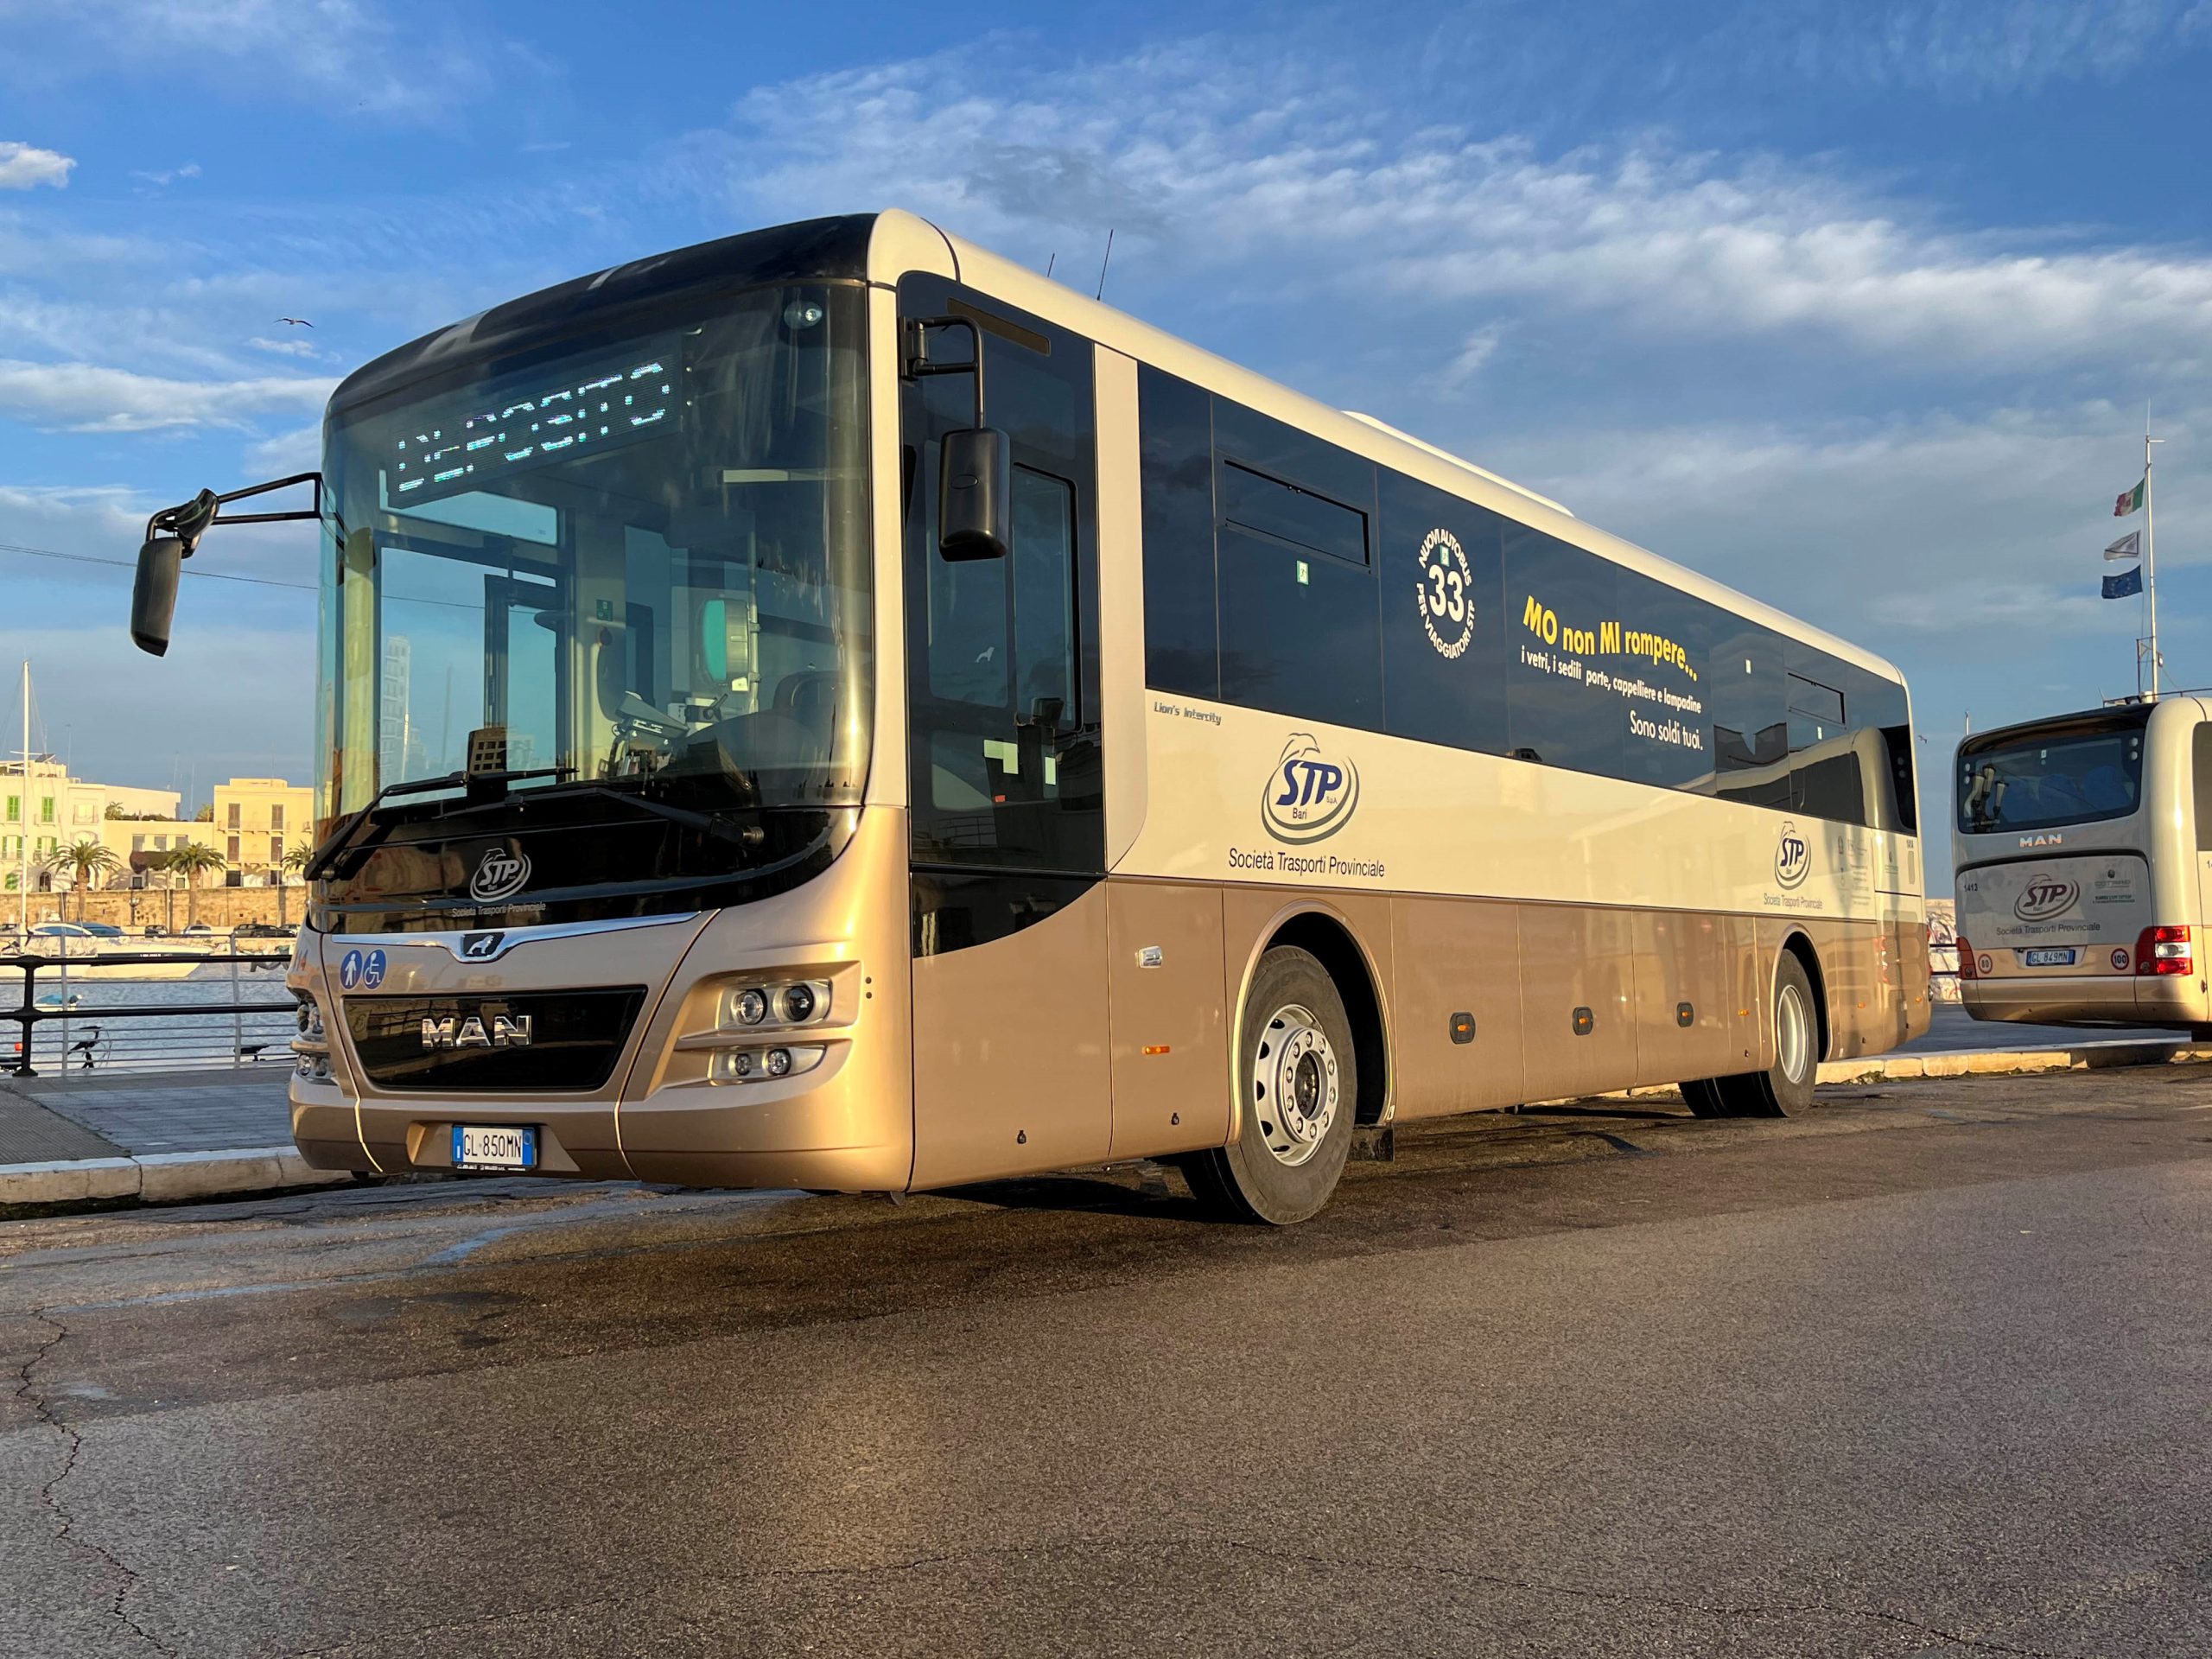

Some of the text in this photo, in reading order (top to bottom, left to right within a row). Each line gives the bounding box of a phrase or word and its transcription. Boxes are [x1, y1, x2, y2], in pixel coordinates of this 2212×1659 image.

[1418, 528, 1472, 587] NUOVI AUTOBUS
[1428, 564, 1465, 622] 33
[1416, 582, 1476, 659] PER VIAGGIATORI STP
[1522, 595, 1698, 682] MO non MI rompere...
[1521, 645, 1701, 714] i vetri, i sedili porte, cappelliere e lampadine
[1154, 702, 1222, 726] Lion's Intercity
[1630, 709, 1703, 751] Sono soldi tuoi.
[1275, 760, 1343, 806] STP
[1292, 807, 1307, 820] Bari
[1780, 838, 1804, 867] STP
[2019, 834, 2063, 848] MAN
[477, 860, 519, 887] STP
[1229, 848, 1385, 877] Società Trasporti Provinciale
[2023, 884, 2068, 908] STP
[1996, 922, 2101, 936] Società Trasporti Provinciale
[2031, 951, 2041, 962] GL
[2113, 955, 2127, 964] 100
[422, 1014, 532, 1048] MAN
[464, 1135, 478, 1156] GL
[483, 1135, 522, 1158] 850MN
